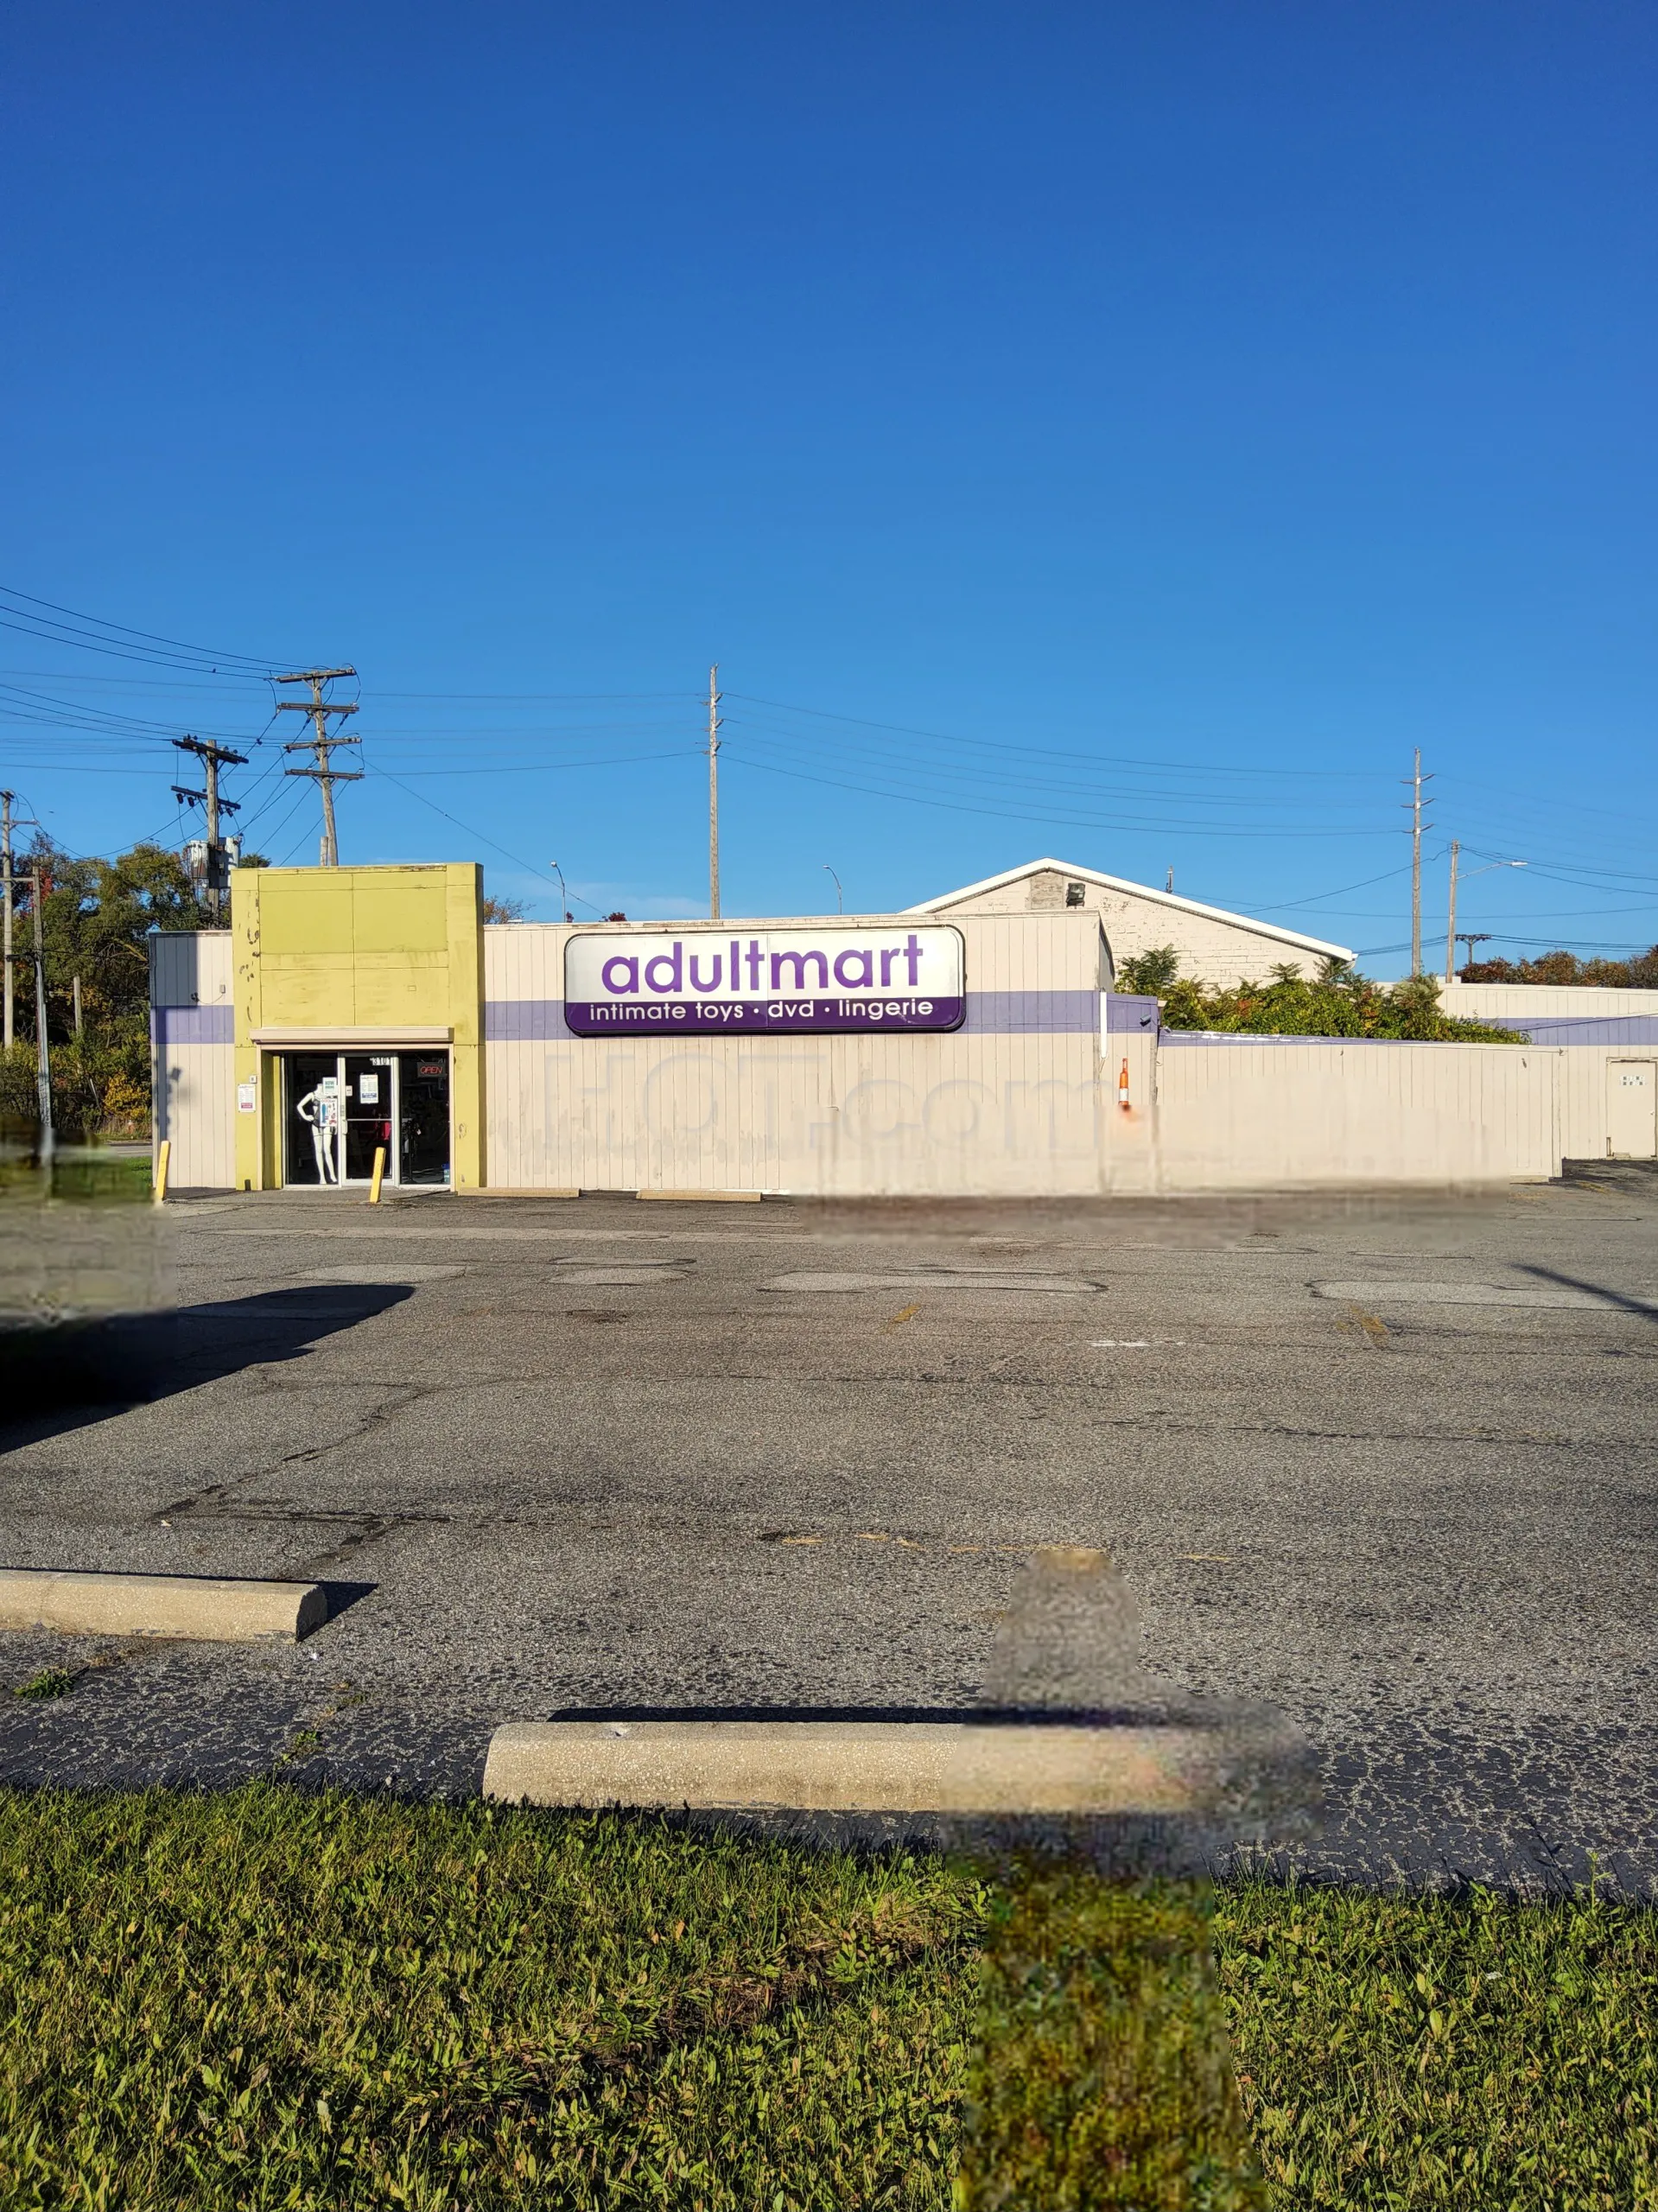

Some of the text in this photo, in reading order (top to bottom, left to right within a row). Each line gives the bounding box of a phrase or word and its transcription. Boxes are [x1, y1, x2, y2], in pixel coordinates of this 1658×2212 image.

[601, 934, 924, 995] adultmart
[589, 998, 934, 1021] intimate toys dvd lingerie
[420, 1065, 443, 1074] OPEN
